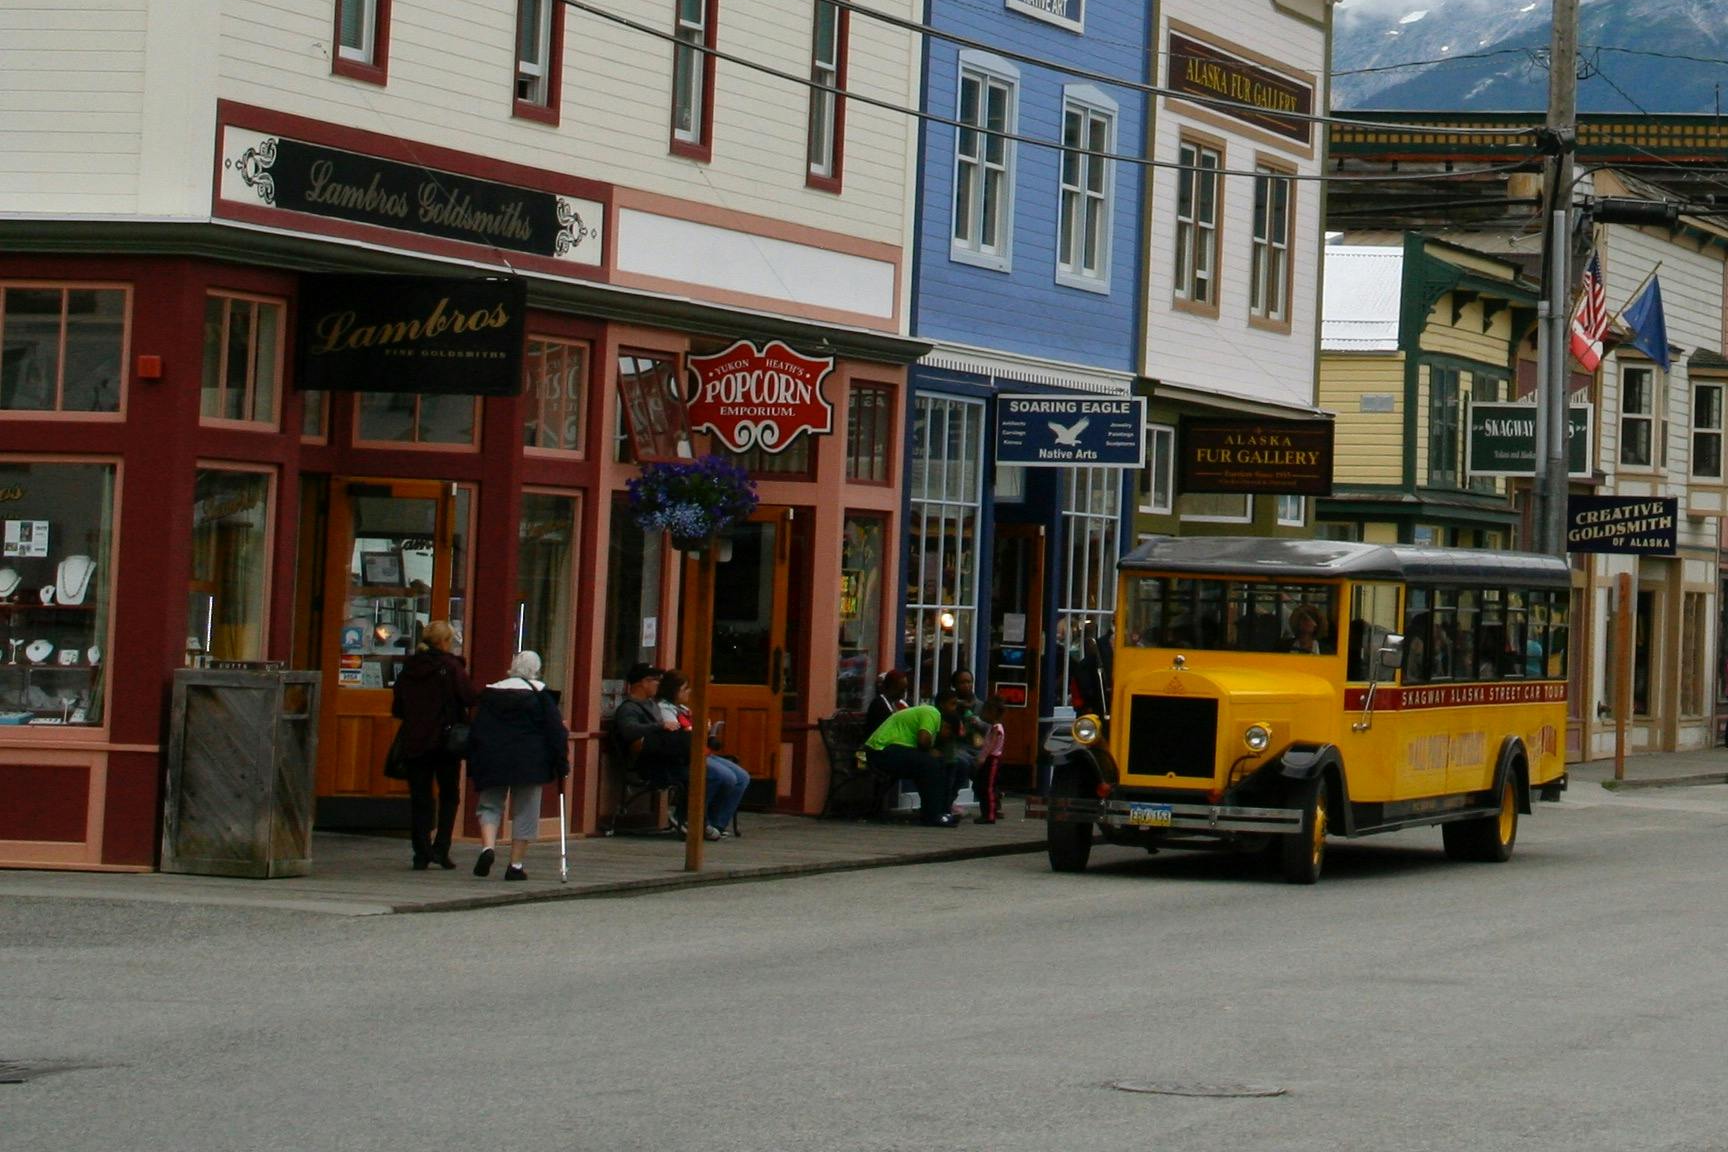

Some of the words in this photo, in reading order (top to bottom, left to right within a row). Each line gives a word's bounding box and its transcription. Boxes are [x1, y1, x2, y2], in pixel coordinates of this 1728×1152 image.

[1185, 57, 1227, 94] ALASKA
[1231, 73, 1251, 102] FUR
[305, 160, 408, 218] Lambros
[418, 181, 532, 241] Goldsmiths
[312, 298, 510, 356] Lambros
[715, 359, 749, 375] YUKON
[705, 370, 812, 404] POPCORN
[1010, 401, 1077, 412] SOARING
[1082, 402, 1130, 414] EAGLE
[1484, 419, 1535, 437] SKAGWAY
[1224, 435, 1292, 446] ALASKA
[1039, 449, 1073, 459] Native
[1075, 449, 1098, 460] Arts
[1197, 448, 1231, 463] FUR
[1237, 450, 1320, 465] GALLERY
[1576, 502, 1664, 525] CREATIVE
[1568, 516, 1672, 542] GOLDSMITH
[1612, 538, 1624, 546] OF
[1630, 538, 1670, 548] ALASKA
[1402, 689, 1446, 706] SKAGWAY
[1451, 688, 1485, 702] ALASKA
[1489, 686, 1520, 700] STREET
[1524, 685, 1540, 699] CAR
[1545, 685, 1564, 698] TOUR
